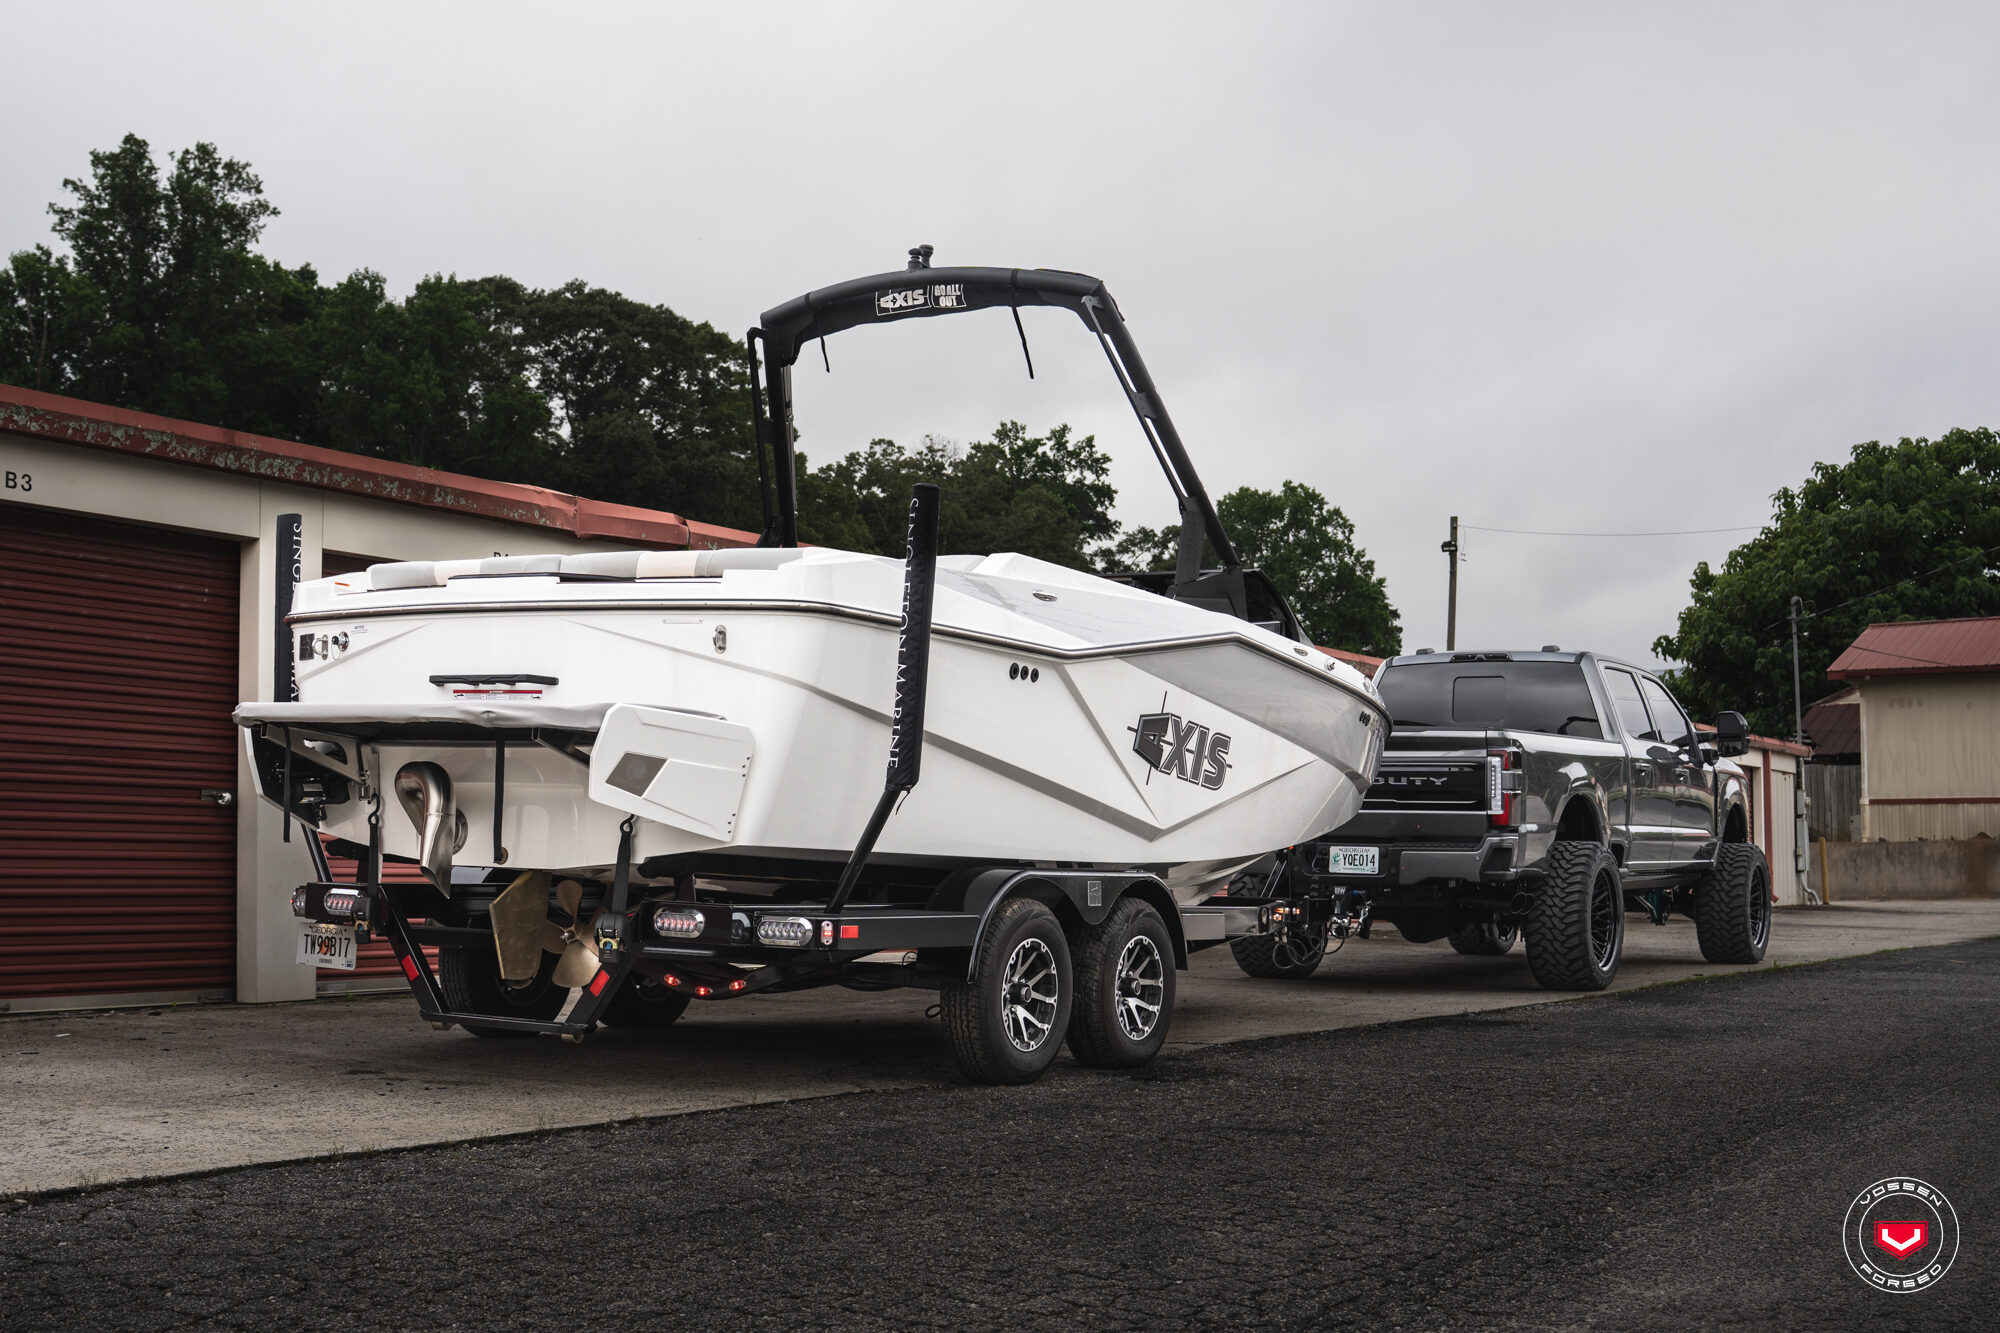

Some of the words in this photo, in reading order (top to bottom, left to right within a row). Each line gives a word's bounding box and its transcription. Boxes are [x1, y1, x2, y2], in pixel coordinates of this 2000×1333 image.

[880, 289, 925, 308] AXIS
[934, 285, 946, 297] GO
[946, 284, 961, 296] ALL
[939, 296, 957, 307] OUT
[5, 470, 32, 492] B3
[888, 664, 908, 769] MARINE
[1132, 712, 1232, 791] AXIS
[1342, 853, 1376, 867] YQE014
[311, 925, 344, 936] GEORGIA
[303, 933, 351, 958] TW99B17
